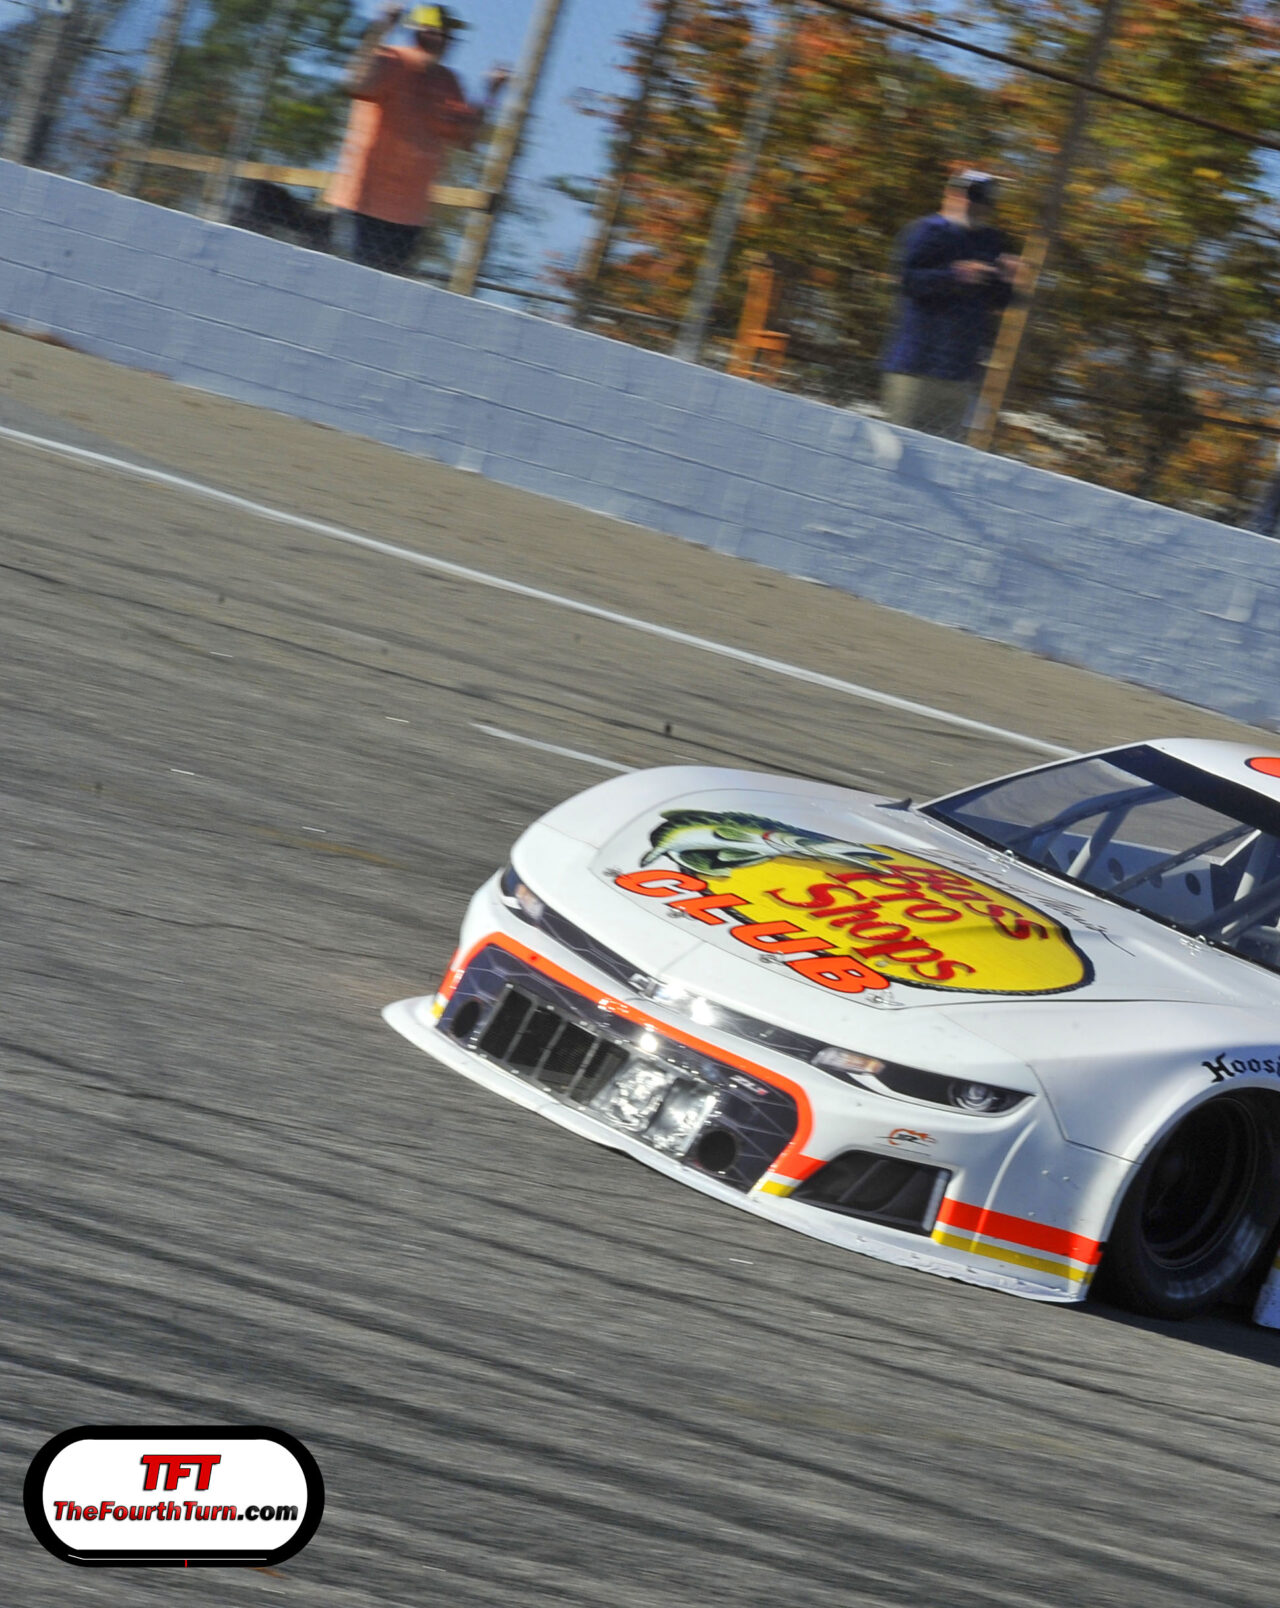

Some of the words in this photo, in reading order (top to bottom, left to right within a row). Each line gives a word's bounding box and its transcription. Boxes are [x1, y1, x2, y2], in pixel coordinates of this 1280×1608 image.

[614, 869, 892, 994] CLUB
[764, 882, 977, 982] Shops
[826, 866, 963, 923] Pro
[877, 861, 1048, 941] Bass
